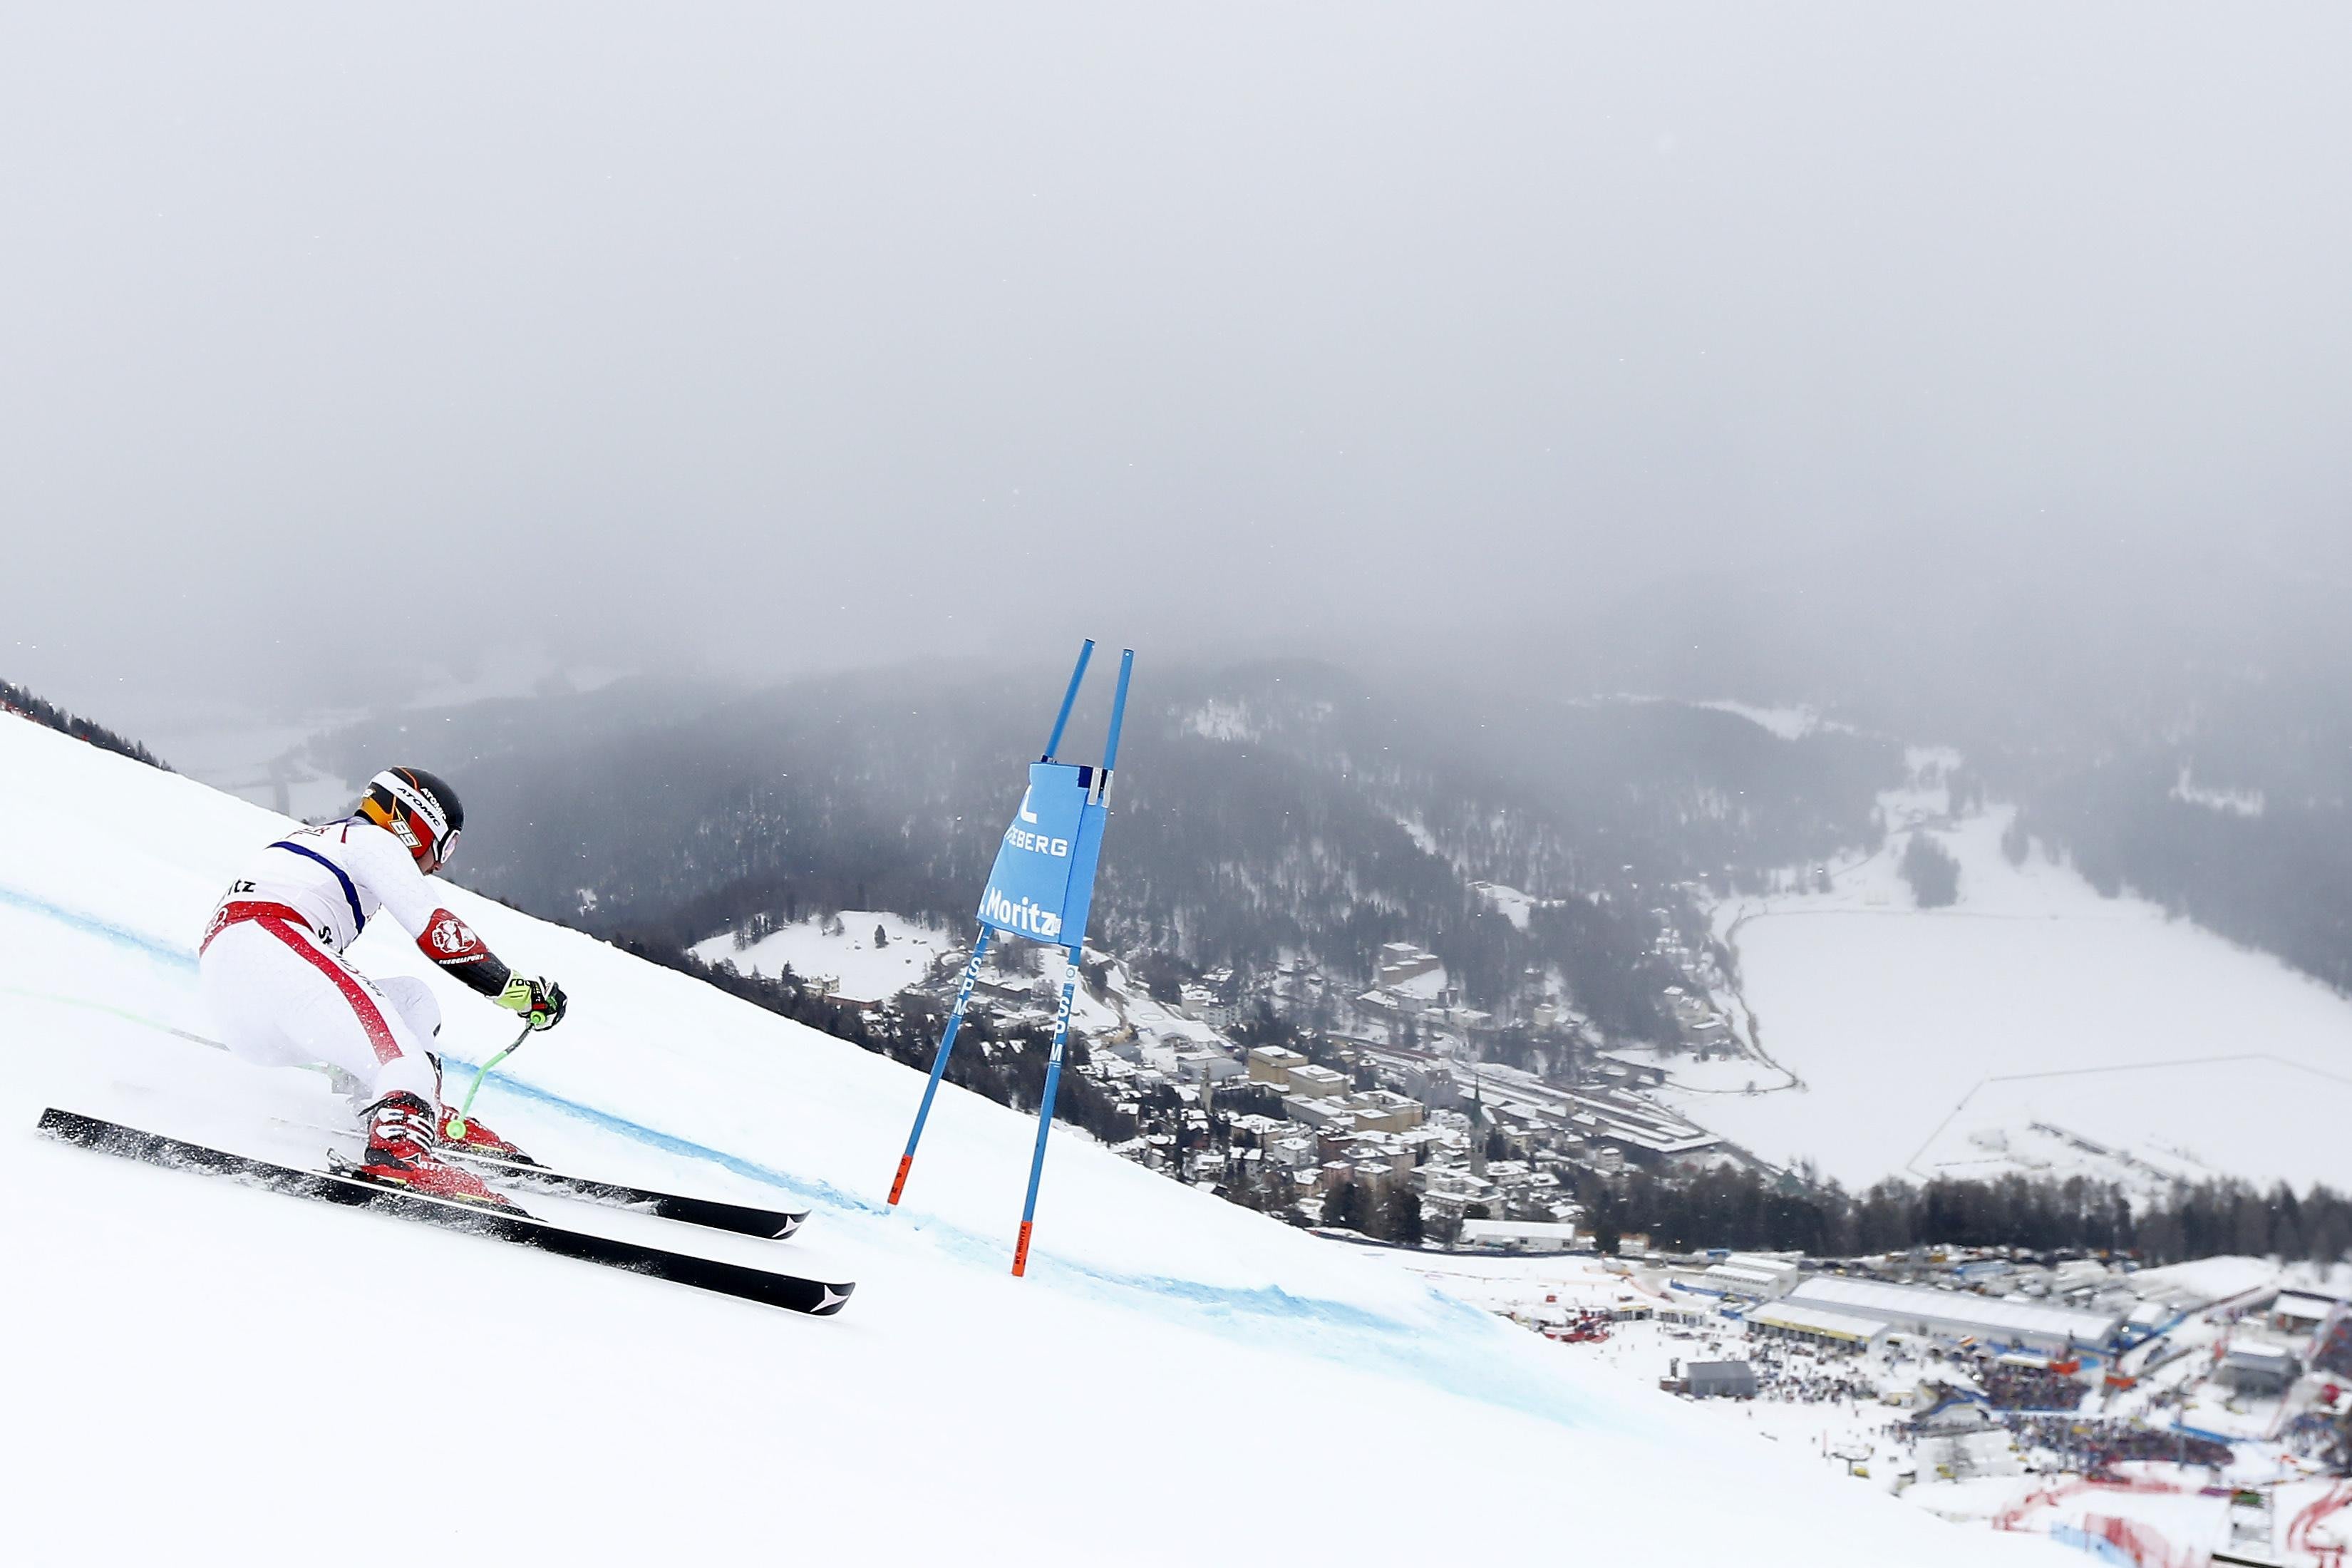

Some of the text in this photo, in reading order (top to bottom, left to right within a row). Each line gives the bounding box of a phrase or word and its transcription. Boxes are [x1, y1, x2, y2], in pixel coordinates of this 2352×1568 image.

[396, 787, 440, 827] ATOMIC
[420, 787, 447, 820] ATOMIC
[390, 820, 420, 847] 89
